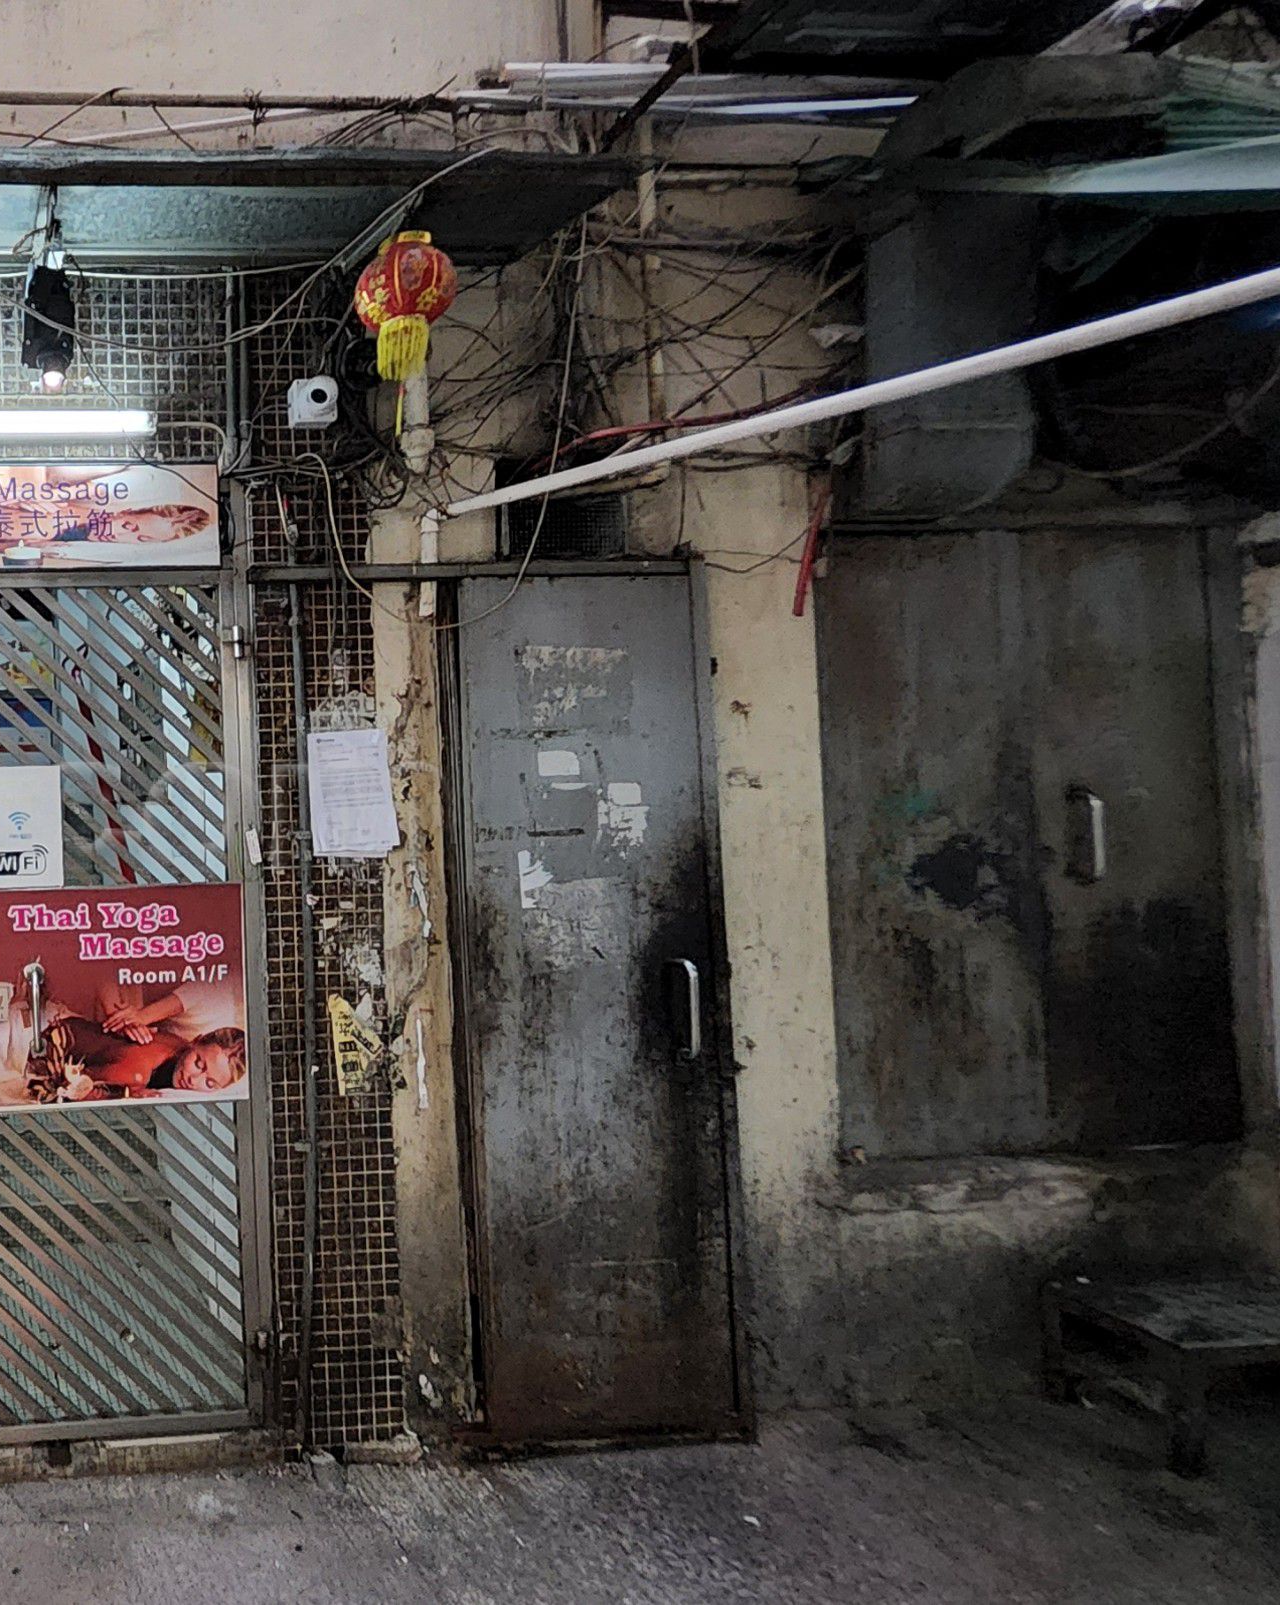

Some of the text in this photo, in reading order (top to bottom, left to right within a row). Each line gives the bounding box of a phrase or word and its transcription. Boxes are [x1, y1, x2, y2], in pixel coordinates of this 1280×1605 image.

[8, 902, 179, 935] Thai Yoga
[79, 931, 224, 962] Massage
[118, 964, 228, 985] Room A1/F
